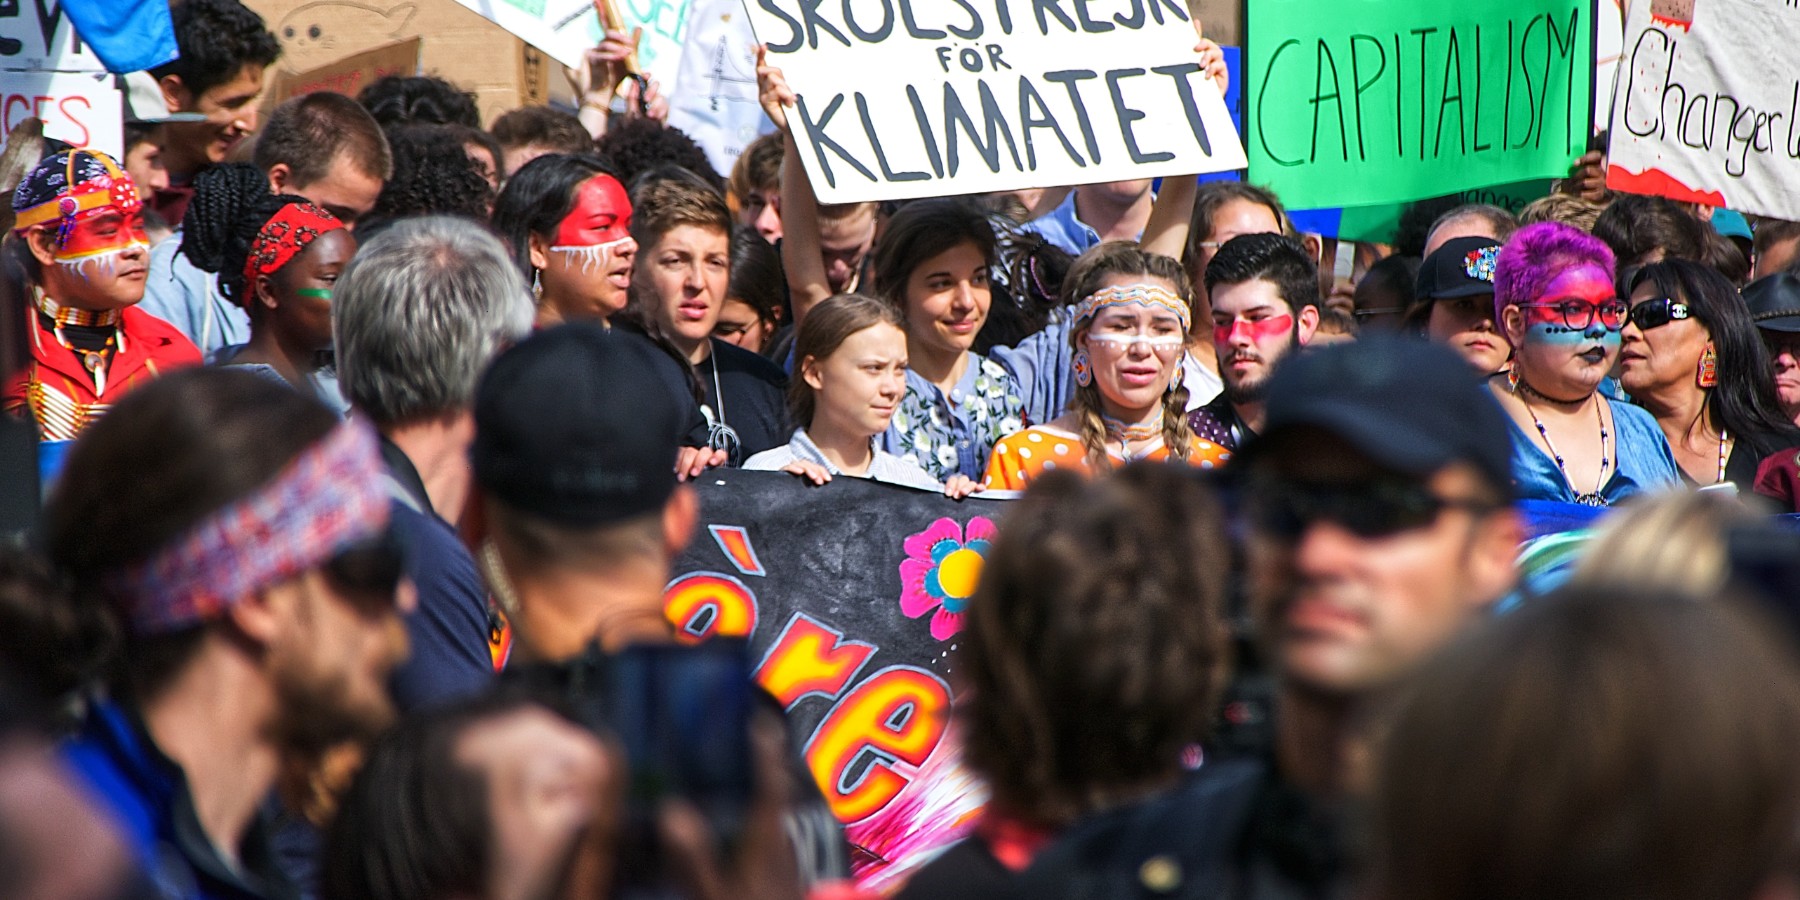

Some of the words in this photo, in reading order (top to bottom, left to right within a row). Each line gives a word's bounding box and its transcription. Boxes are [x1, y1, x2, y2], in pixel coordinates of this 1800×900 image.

[757, 0, 1189, 53] SKOLS
[935, 42, 1013, 73] FÖR
[0, 93, 91, 149] CES
[796, 63, 1212, 189] KLIMATET
[1257, 8, 1578, 166] CAPITALISM
[1625, 28, 1783, 177] Changer
